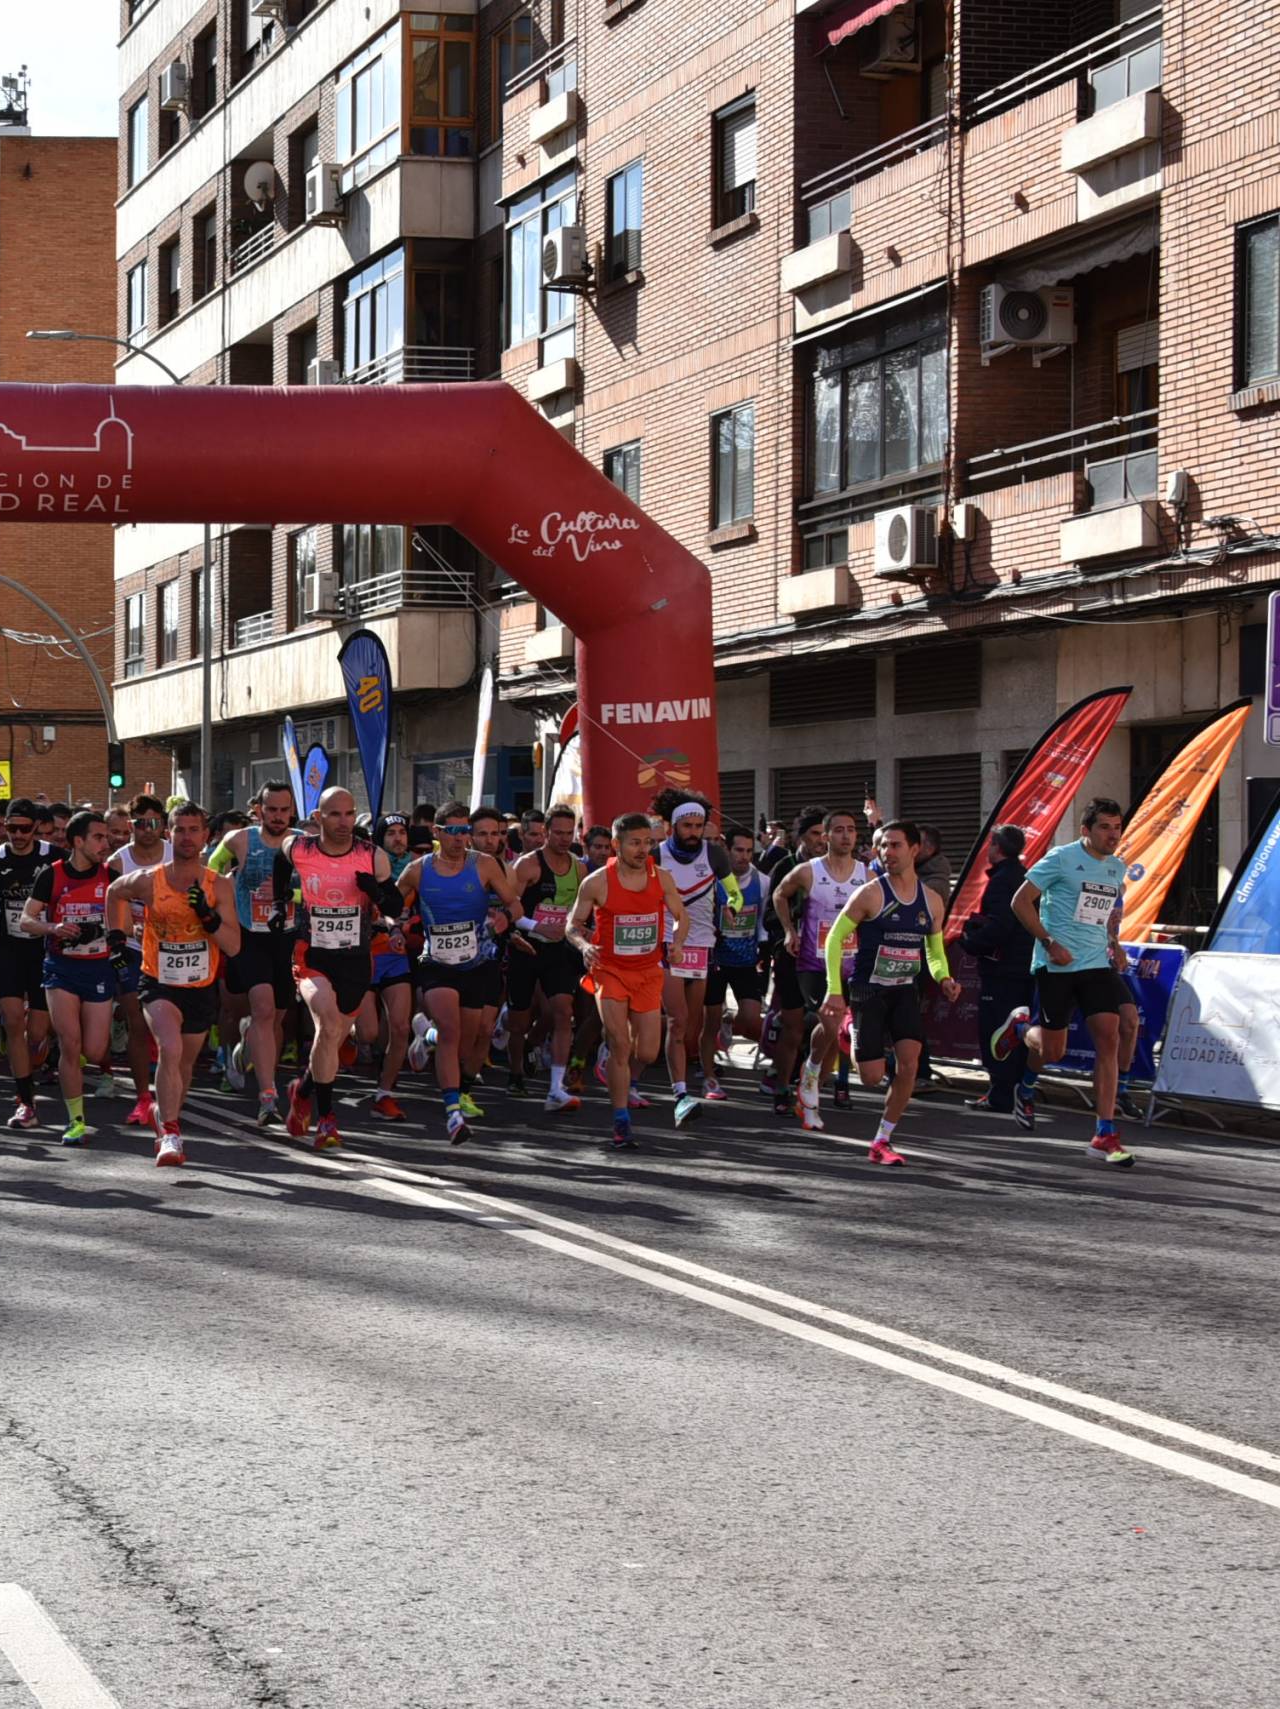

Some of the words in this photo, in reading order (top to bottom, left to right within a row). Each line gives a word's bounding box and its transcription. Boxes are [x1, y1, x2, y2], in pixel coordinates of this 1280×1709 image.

[96, 474, 132, 489] DE
[37, 493, 129, 513] REAL
[508, 523, 531, 544] La
[541, 511, 640, 545] Cultura
[532, 546, 555, 557] del
[566, 533, 623, 561] Vino
[601, 697, 711, 725] FENAVIN
[1083, 895, 1111, 911] 2900
[317, 920, 354, 932] 2945
[622, 927, 652, 940] 1459
[162, 942, 205, 950] SOLISS
[437, 935, 470, 949] 2623
[166, 955, 200, 968] 2612
[885, 960, 913, 973] 323
[1170, 1047, 1216, 1063] CIUDAD
[1217, 1049, 1246, 1066] REAL
